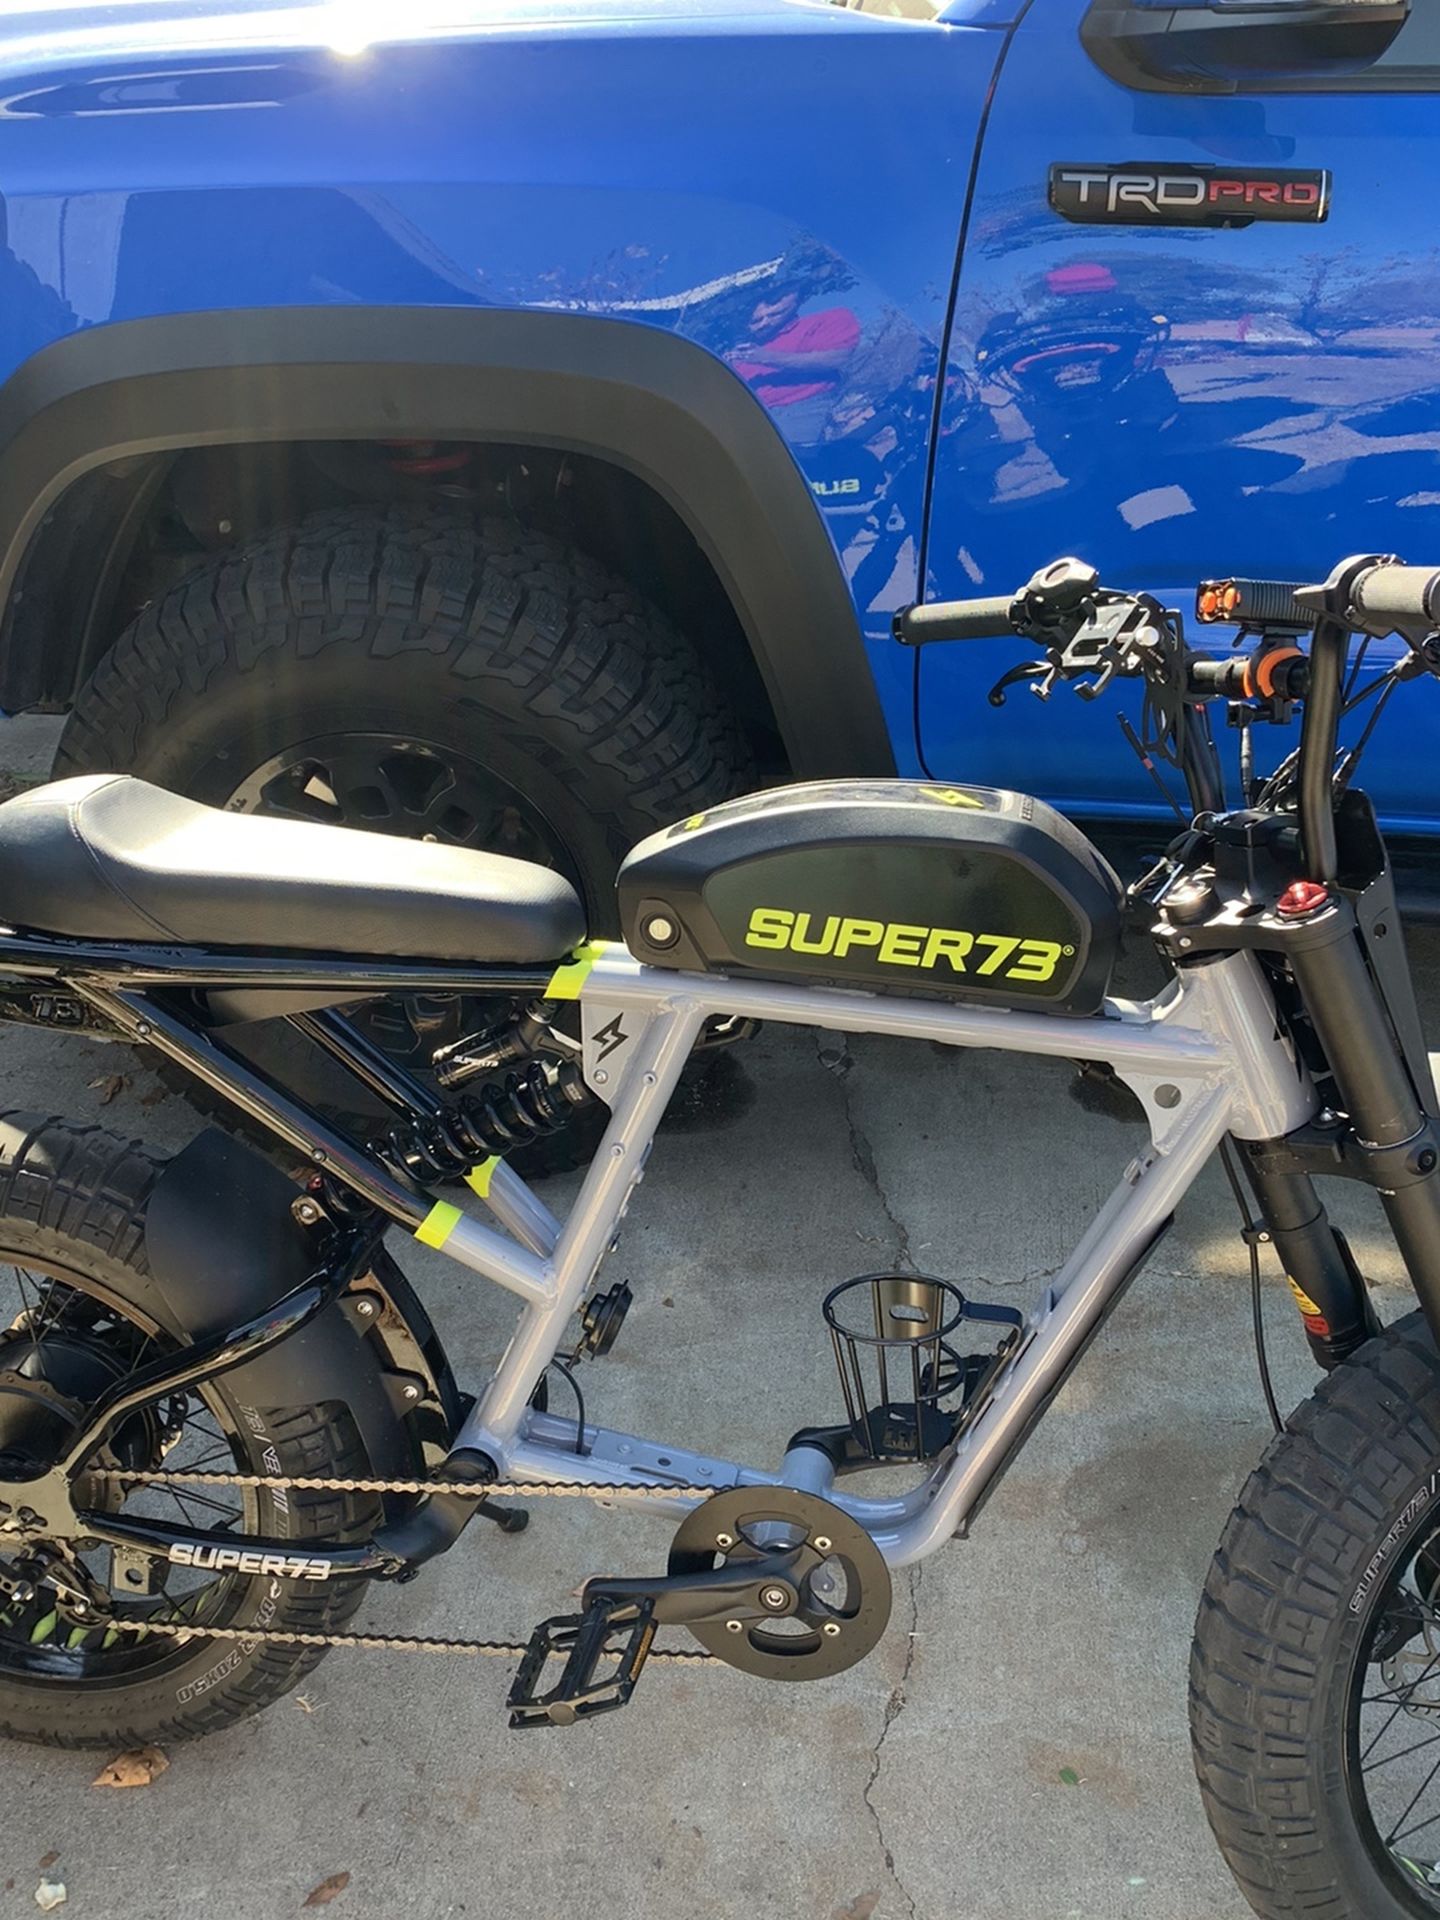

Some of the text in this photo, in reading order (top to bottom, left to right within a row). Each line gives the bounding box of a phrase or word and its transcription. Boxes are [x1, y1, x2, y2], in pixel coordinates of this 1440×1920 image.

[1061, 172, 1321, 214] TRD PRO
[168, 1543, 331, 1581] SUPER73
